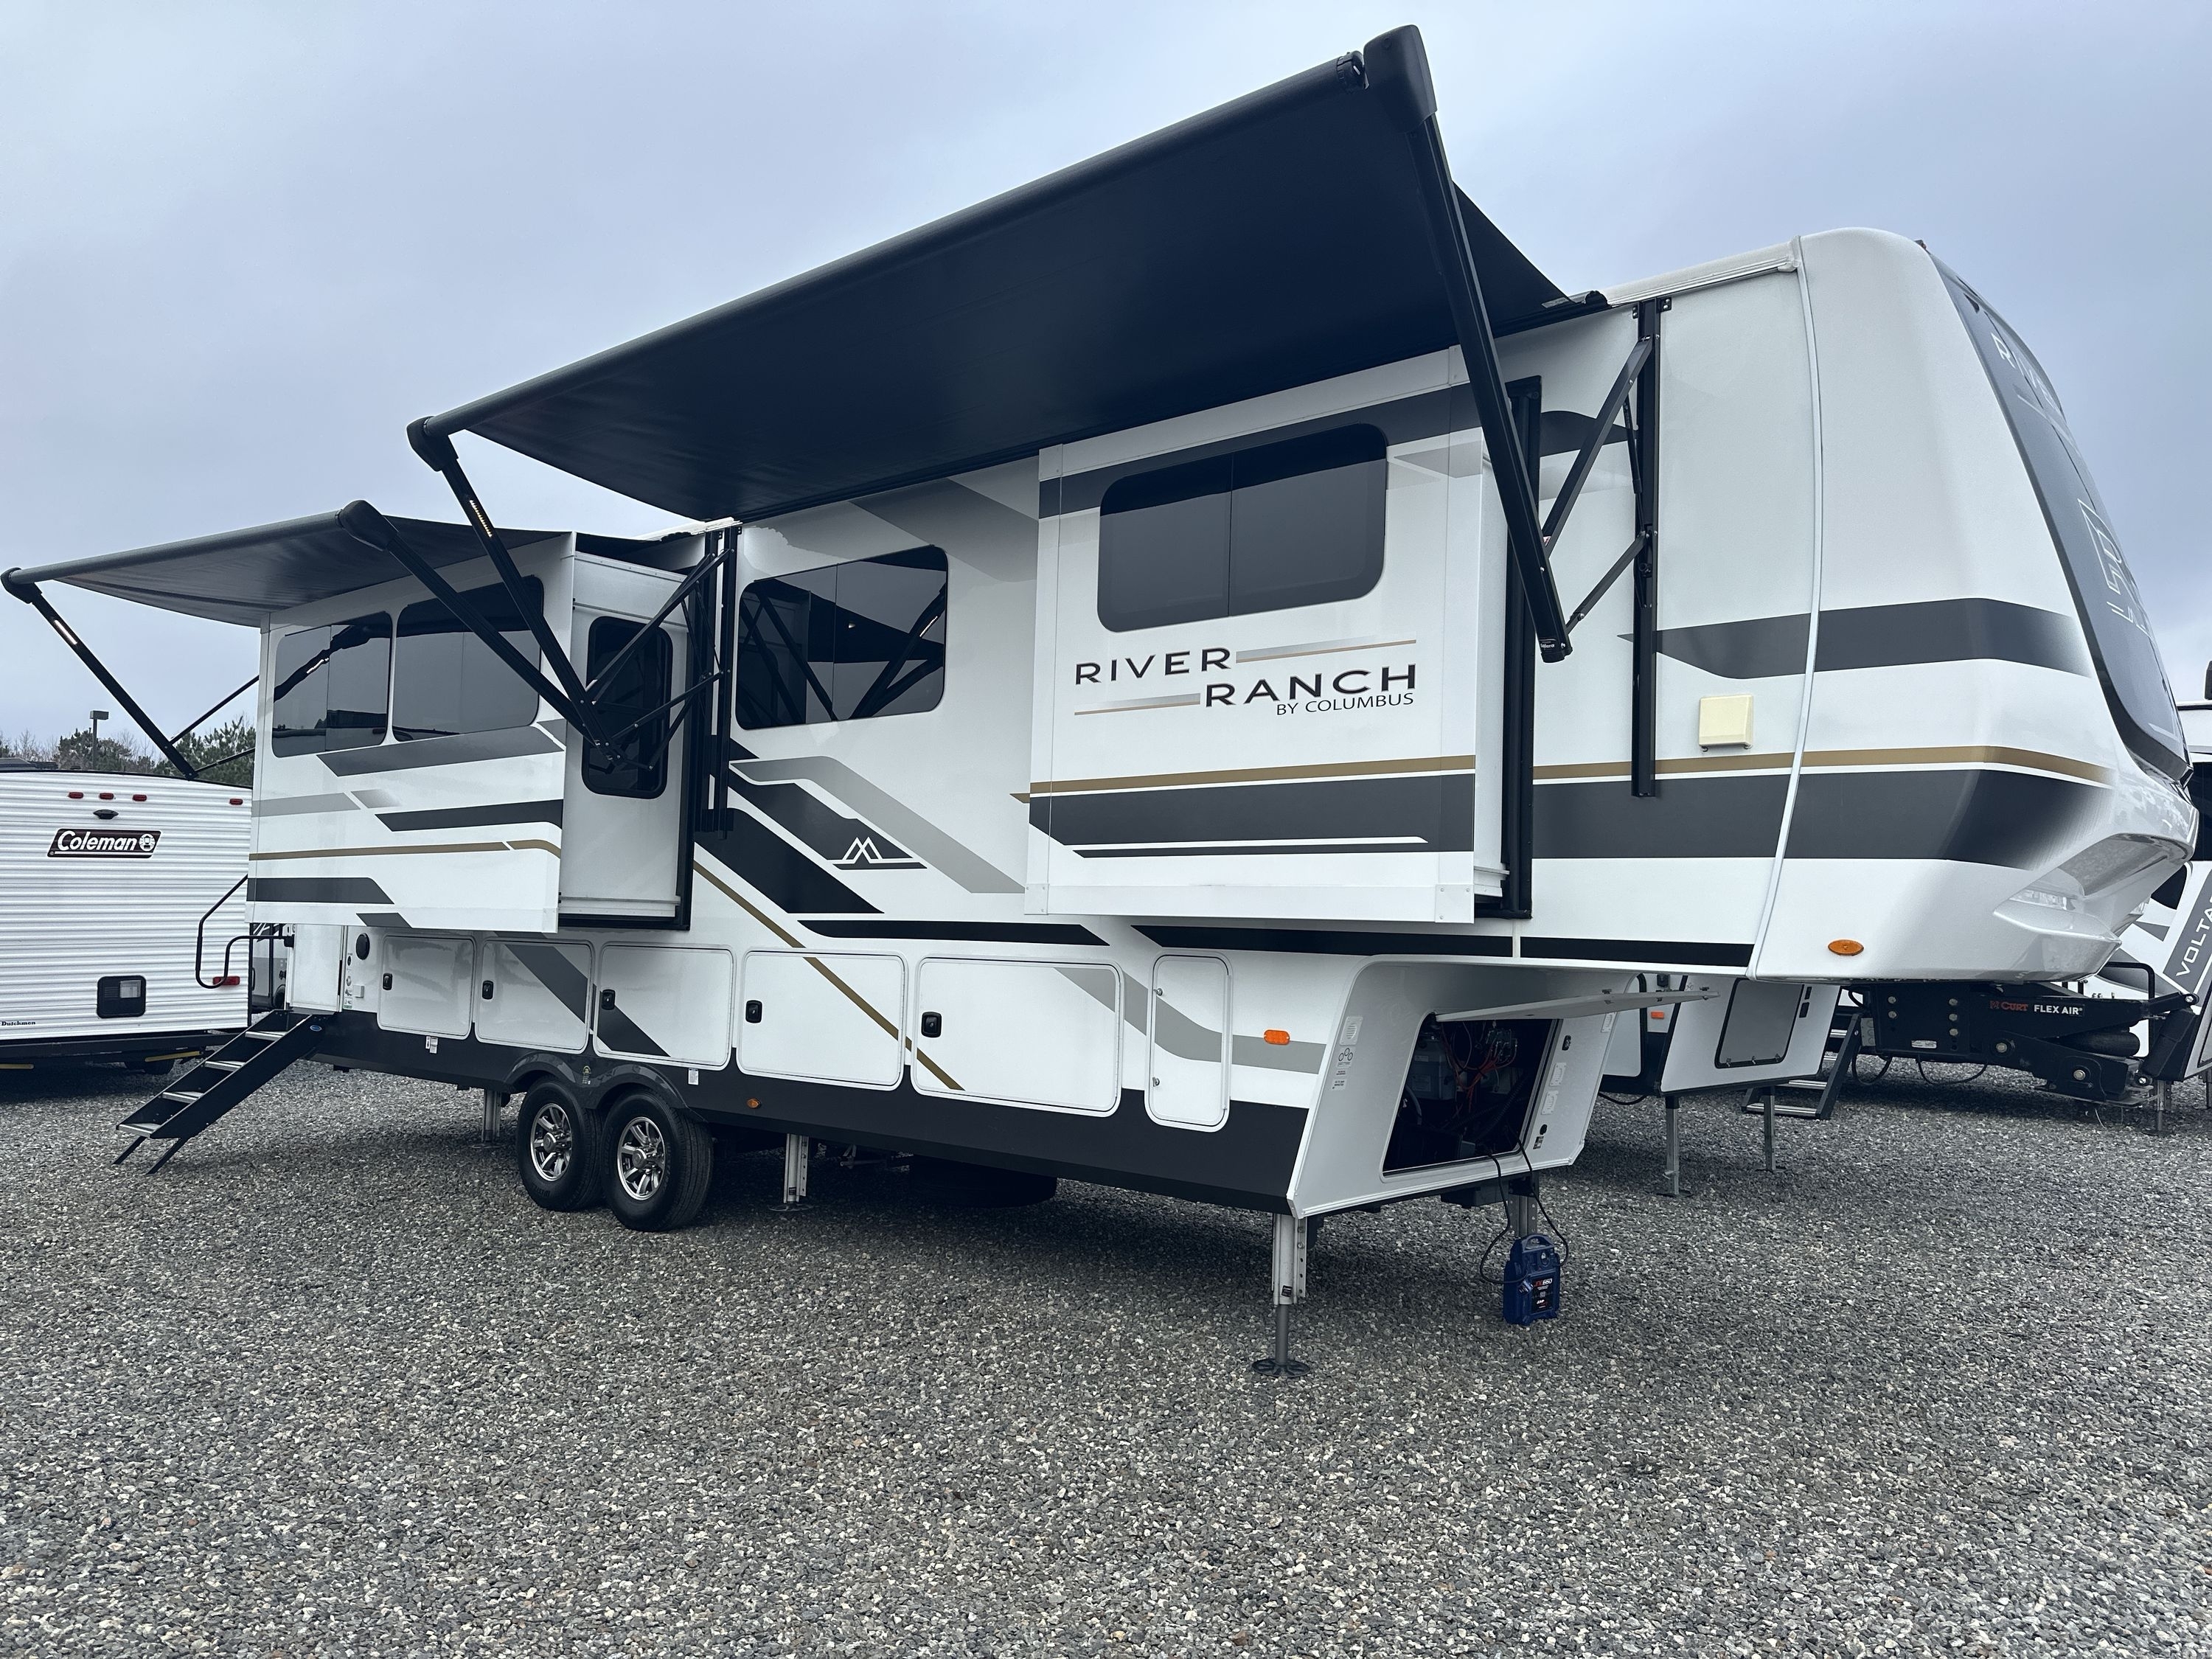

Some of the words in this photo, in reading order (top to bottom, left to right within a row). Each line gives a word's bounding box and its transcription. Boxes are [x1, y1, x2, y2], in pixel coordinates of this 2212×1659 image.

[1075, 647, 1231, 685] RIVER
[1206, 663, 1416, 708] RANCH
[1276, 702, 1298, 715] BY
[1305, 692, 1414, 713] COLUMBUS
[57, 830, 138, 851] Coleman
[2175, 896, 2212, 976] VOLTA
[2034, 1004, 2059, 1014] FLEX
